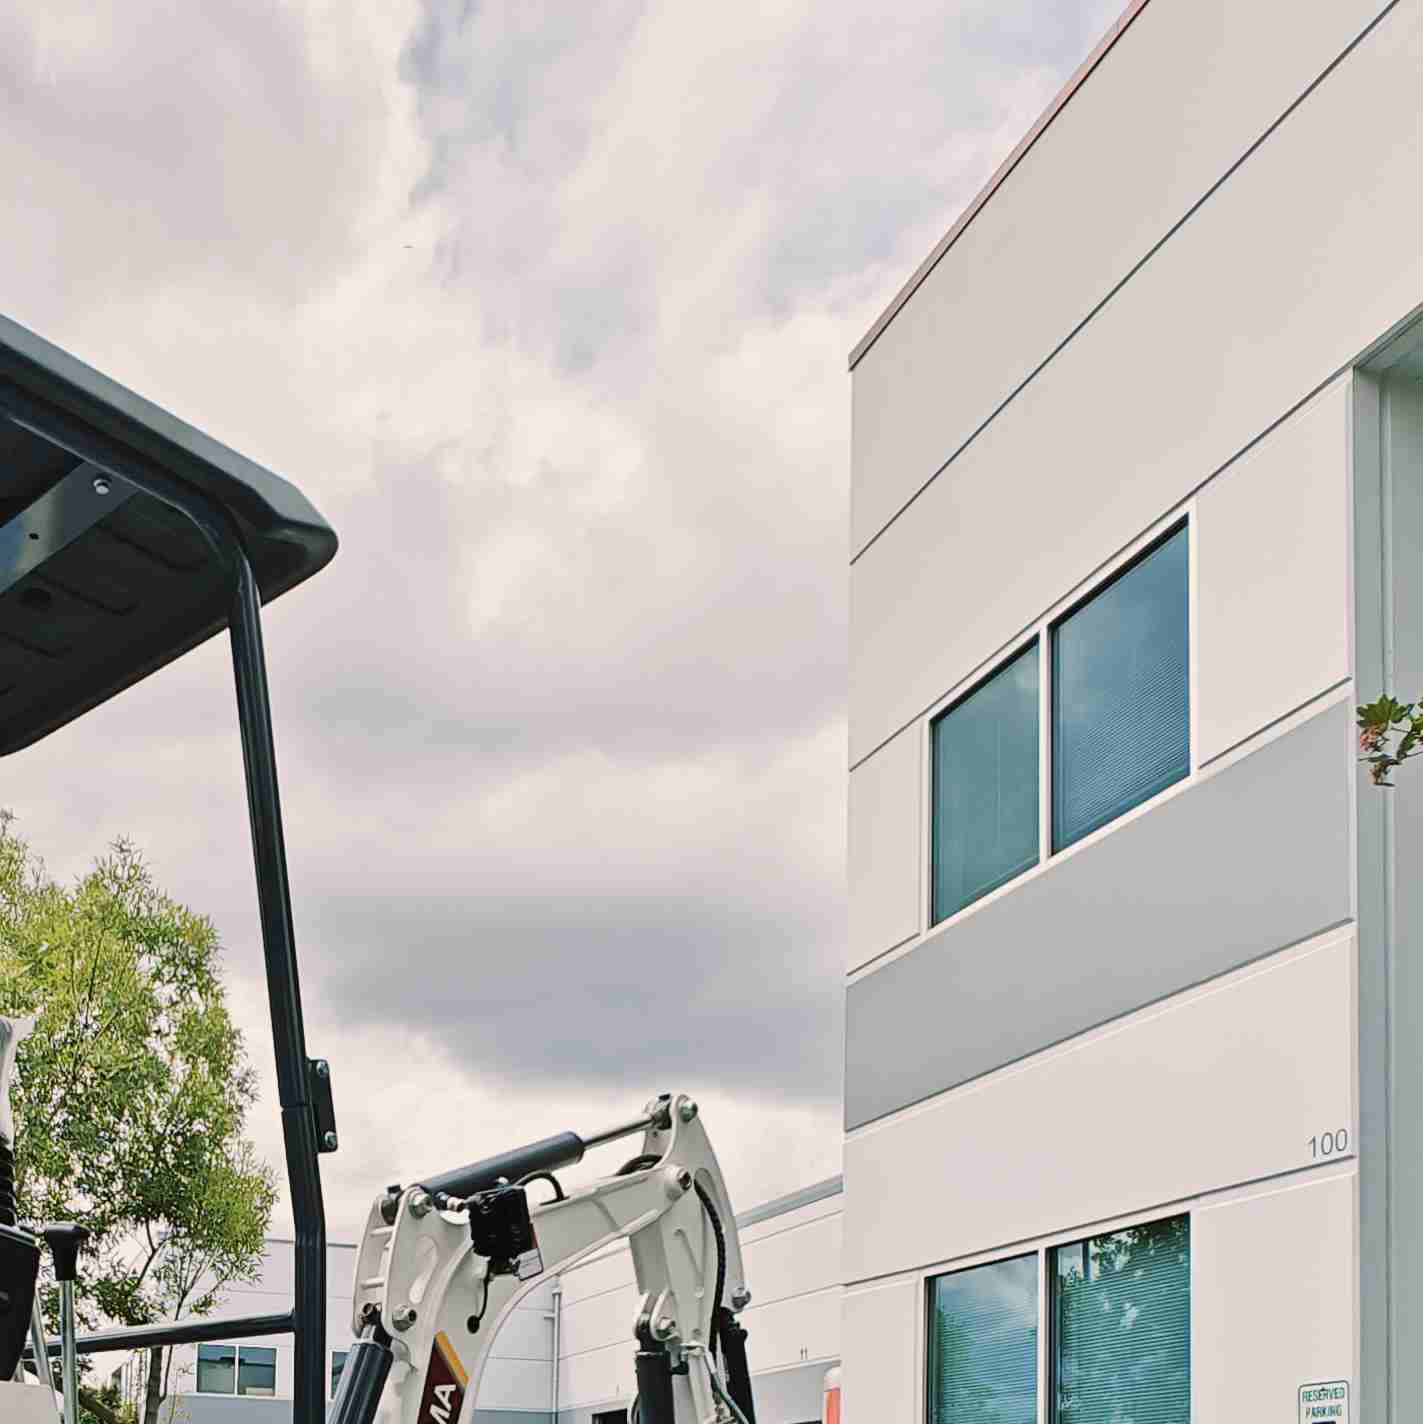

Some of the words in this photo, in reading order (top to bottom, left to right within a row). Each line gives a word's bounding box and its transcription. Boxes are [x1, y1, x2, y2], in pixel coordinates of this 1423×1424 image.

[1307, 1128, 1348, 1158] 100
[1302, 1386, 1345, 1402] RESERVED
[1305, 1403, 1343, 1419] PARKING
